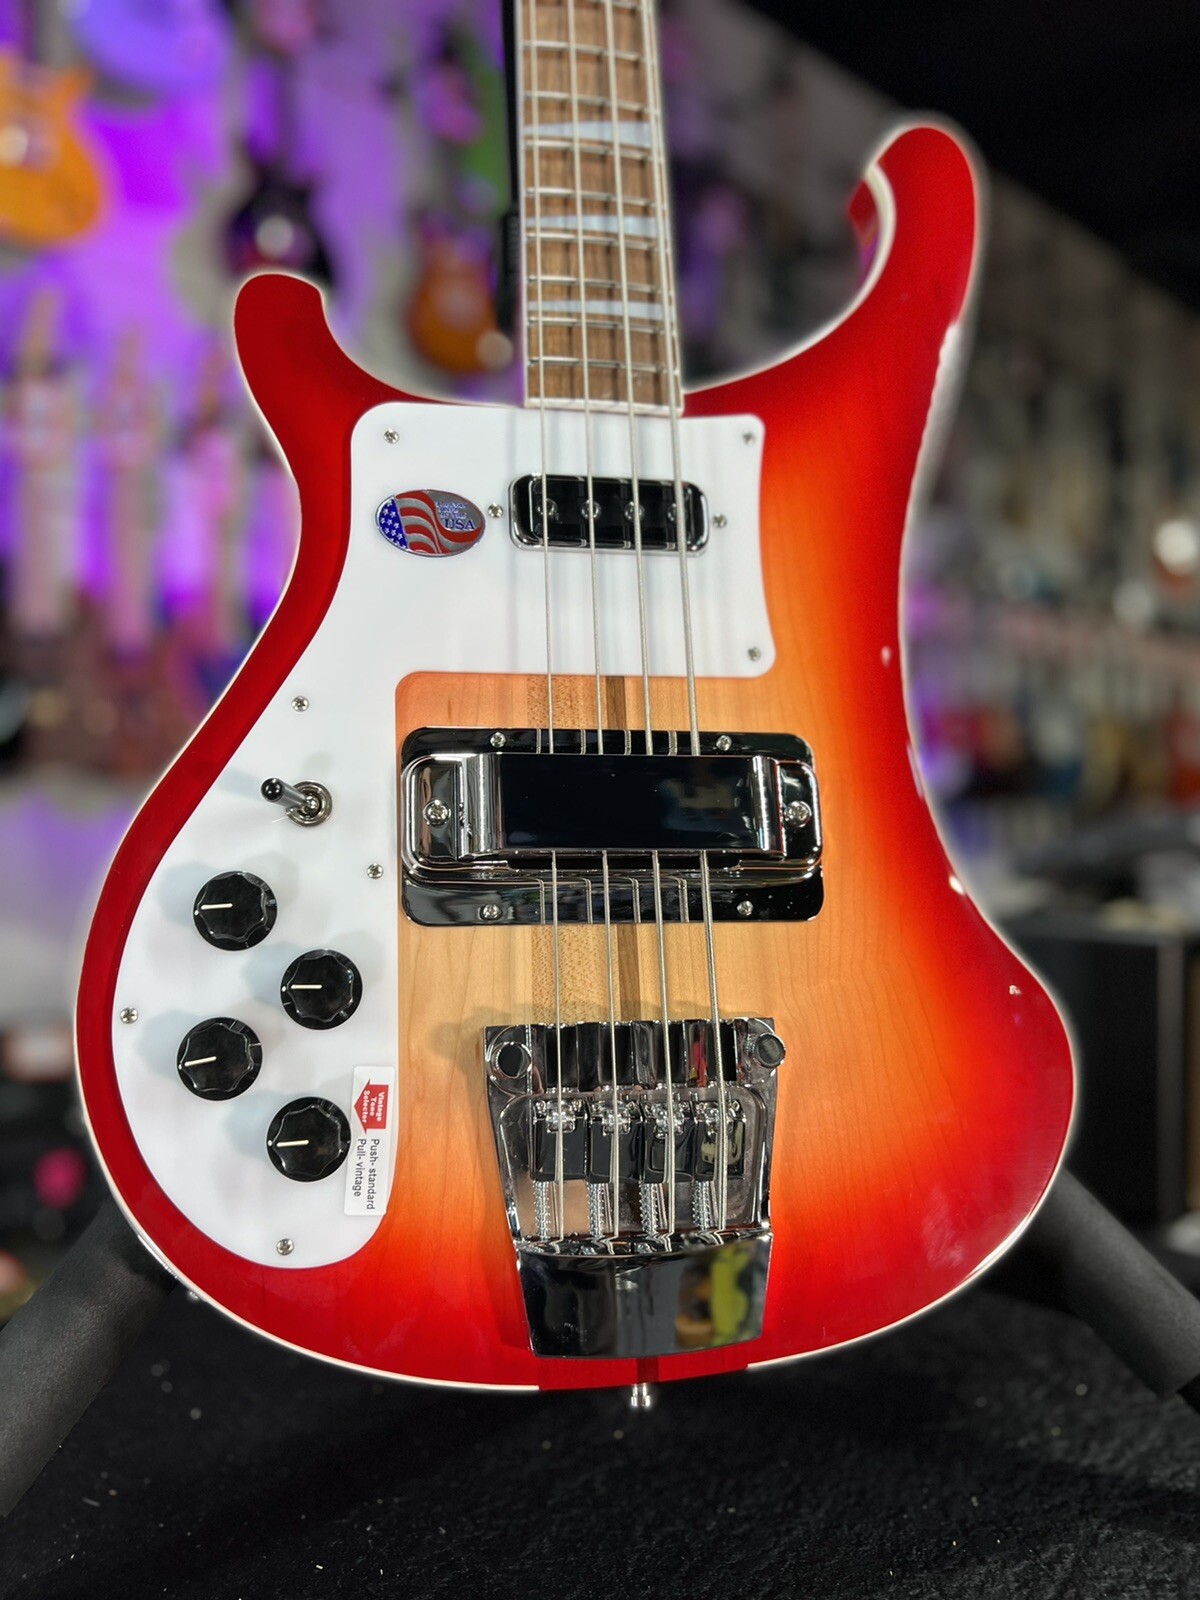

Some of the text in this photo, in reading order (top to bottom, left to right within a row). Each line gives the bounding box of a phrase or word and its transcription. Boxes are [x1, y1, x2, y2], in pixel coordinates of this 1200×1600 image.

[445, 519, 475, 530] USA
[362, 1090, 370, 1123] Selector
[369, 1096, 378, 1117] Tone
[376, 1091, 385, 1122] Vintage
[352, 1161, 364, 1197] vintage
[366, 1168, 377, 1210] standard
